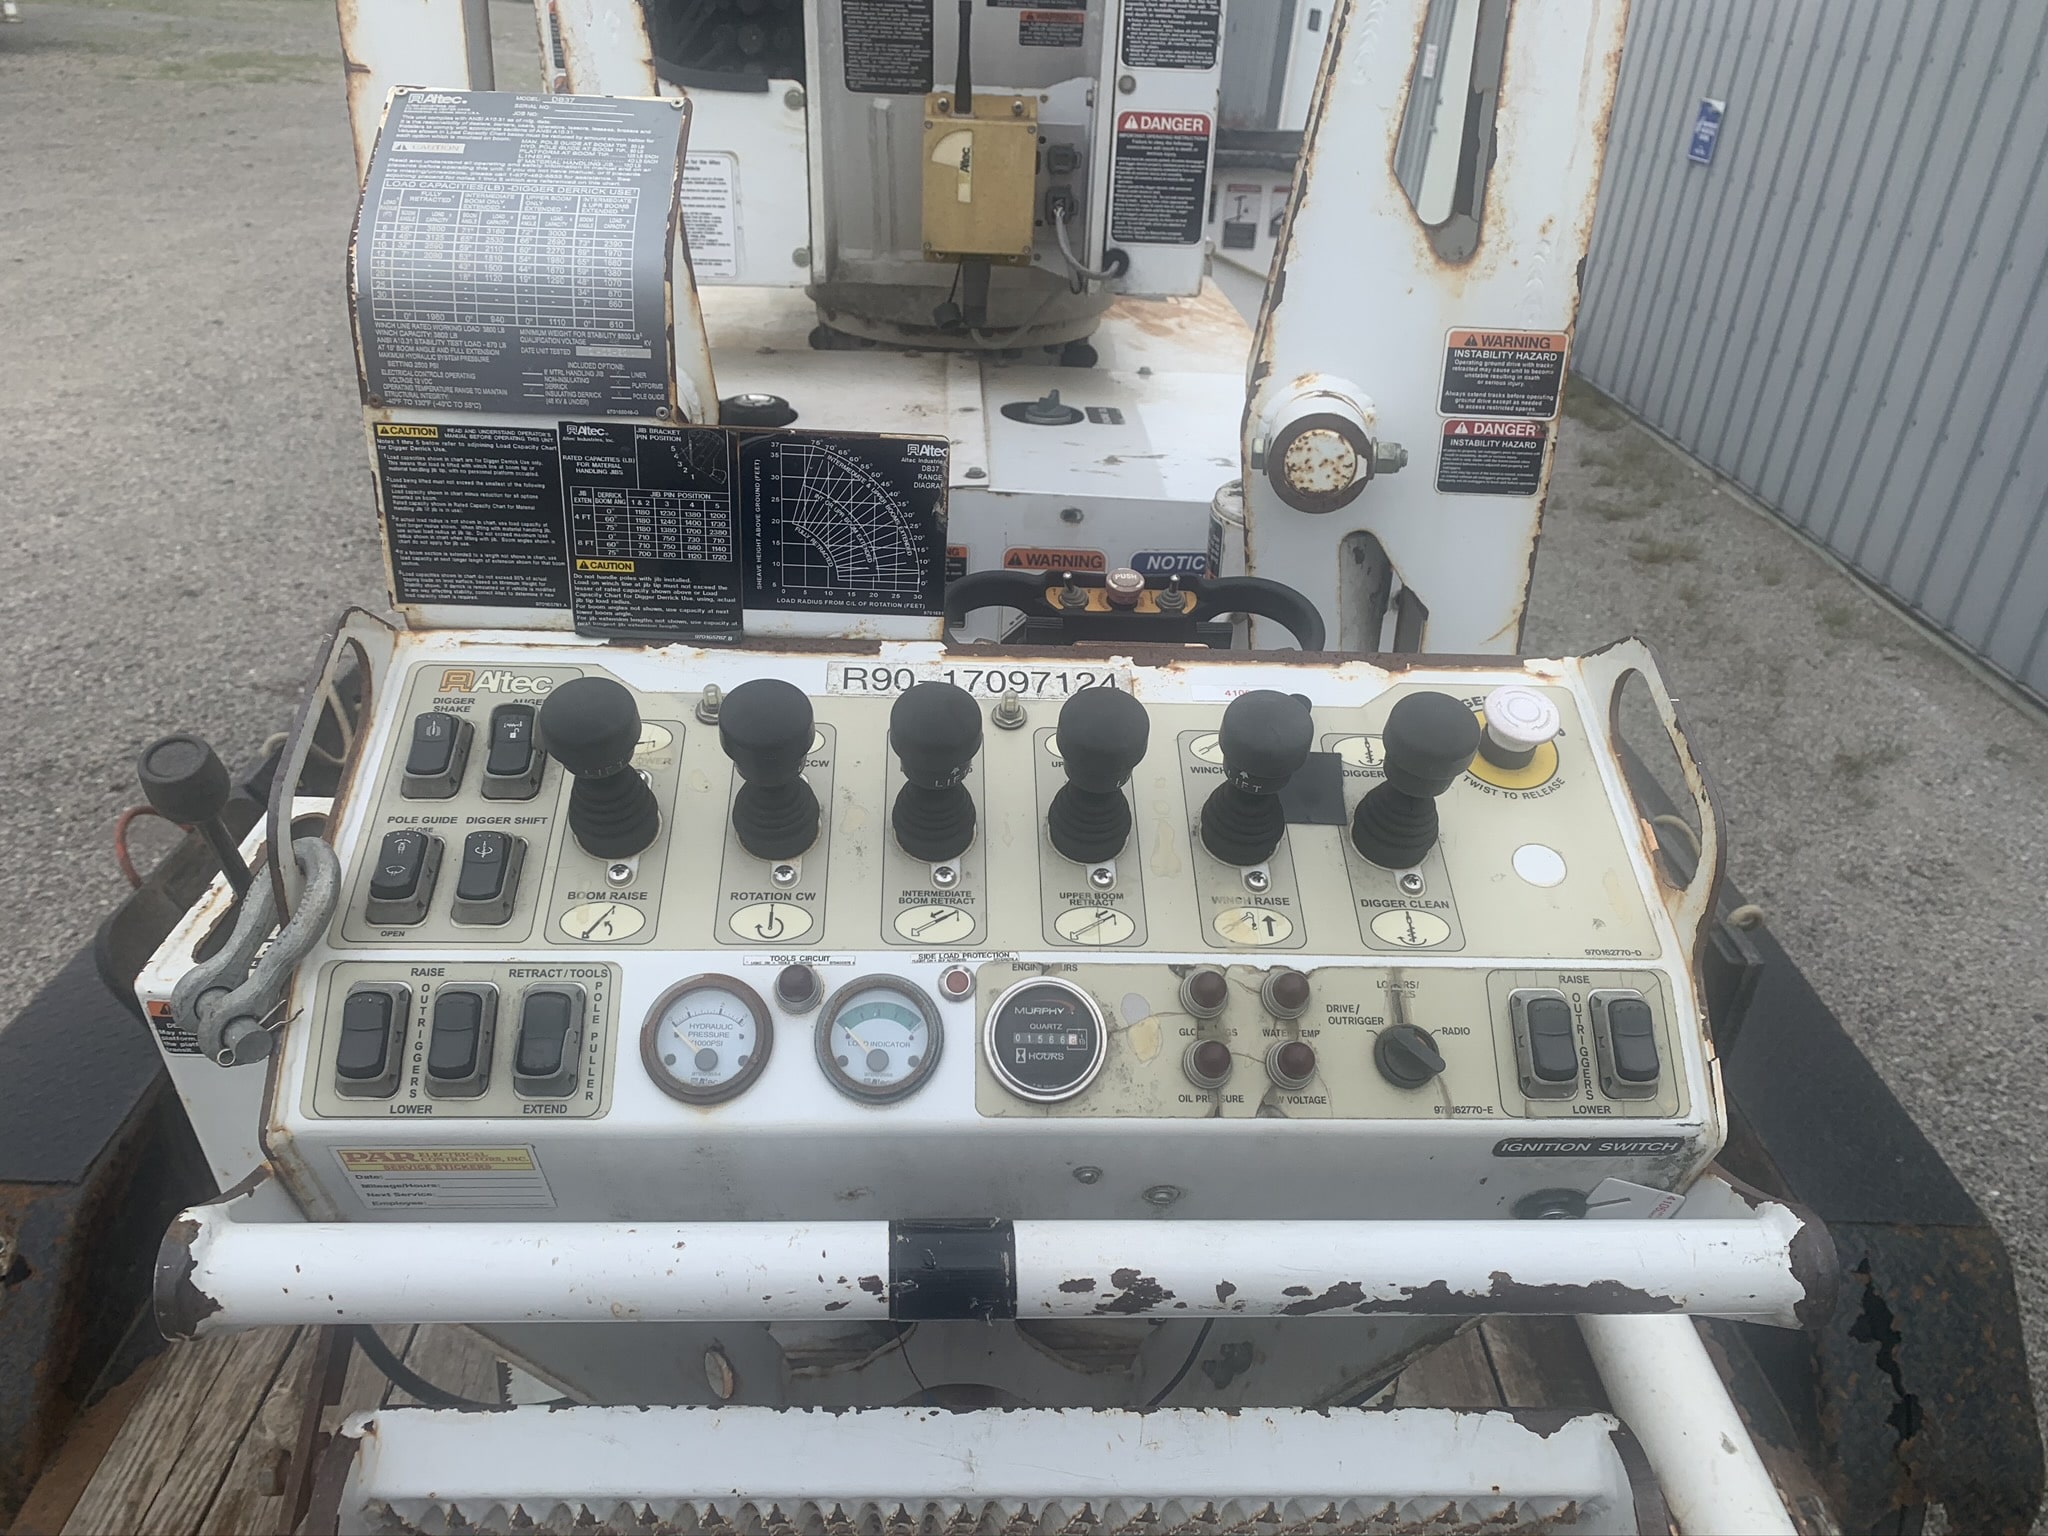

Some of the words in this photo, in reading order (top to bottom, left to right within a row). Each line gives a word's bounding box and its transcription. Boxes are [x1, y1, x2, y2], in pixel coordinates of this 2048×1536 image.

[423, 94, 462, 104] Altec
[1141, 116, 1203, 131] DANGER
[386, 180, 416, 188] LOAD
[557, 187, 606, 195] DERRICK
[1481, 335, 1551, 349] WARNING
[1454, 349, 1514, 360] INSTABILITY
[1515, 352, 1558, 361] HAZARD
[1454, 359, 1483, 367] Operating
[390, 426, 436, 437] CAUTION
[578, 425, 604, 436] Altec
[1474, 423, 1536, 436] DANGER
[1450, 439, 1500, 448] INSTABILITY
[1502, 440, 1537, 449] HAZARD
[920, 444, 948, 457] Altec
[918, 473, 943, 481] RANGE
[1027, 553, 1103, 569] WARNING
[1146, 555, 1206, 570] NOTIC
[590, 562, 632, 571] CAUTION
[471, 670, 553, 694] Altec
[433, 697, 475, 705] DIGGER
[513, 698, 544, 706] AUGE
[1190, 766, 1225, 775] WINCH
[1342, 769, 1385, 778] DIGGER
[1463, 775, 1498, 796] TWIST
[1503, 791, 1518, 800] TO
[1521, 777, 1565, 800] RELEASE
[387, 816, 418, 824] POLE
[421, 816, 458, 824] GUIDE
[466, 816, 512, 825] DIGGER
[514, 816, 548, 825] SHIFT
[567, 891, 606, 901] BOOM
[609, 891, 648, 901] RAISE
[730, 892, 792, 901] ROTATION
[796, 892, 816, 901] CW
[902, 890, 972, 898] INTERMEDIATE
[1059, 892, 1092, 900] UPPER
[1094, 892, 1124, 900] BOOM
[898, 897, 929, 905] BOOM
[1254, 897, 1290, 906] RAISE
[1360, 898, 1405, 908] DIGGER
[1409, 900, 1449, 909] CLEAN
[962, 951, 1010, 959] PROTECTION
[1584, 949, 1642, 957] 970162770-D
[410, 967, 445, 977] RAISE
[1012, 963, 1042, 972] ENGIN
[508, 969, 563, 978] RETRACT
[569, 969, 608, 978] TOOLS
[1558, 974, 1591, 984] RAISE
[591, 981, 603, 1025] POLE
[1014, 1006, 1065, 1014] MURPHY
[1328, 1016, 1384, 1025] OUTRIGGER
[1442, 1027, 1471, 1035] RADIO
[409, 983, 431, 1099] OUTRIGGERS
[1572, 992, 1594, 1101] OUTRIGGERS
[1028, 1052, 1065, 1060] HOURS
[585, 1031, 599, 1101] PULLER
[1178, 1094, 1193, 1103] OIL
[1196, 1094, 1244, 1103] PRESURE
[1287, 1096, 1327, 1105] VOLTAGE
[389, 1104, 433, 1115] LOWER
[522, 1104, 567, 1115] EXTEND
[1572, 1105, 1612, 1115] LOWER
[1501, 1143, 1592, 1152] IGNITION
[1598, 1142, 1679, 1151] SWITCH
[346, 1151, 420, 1163] PAR
